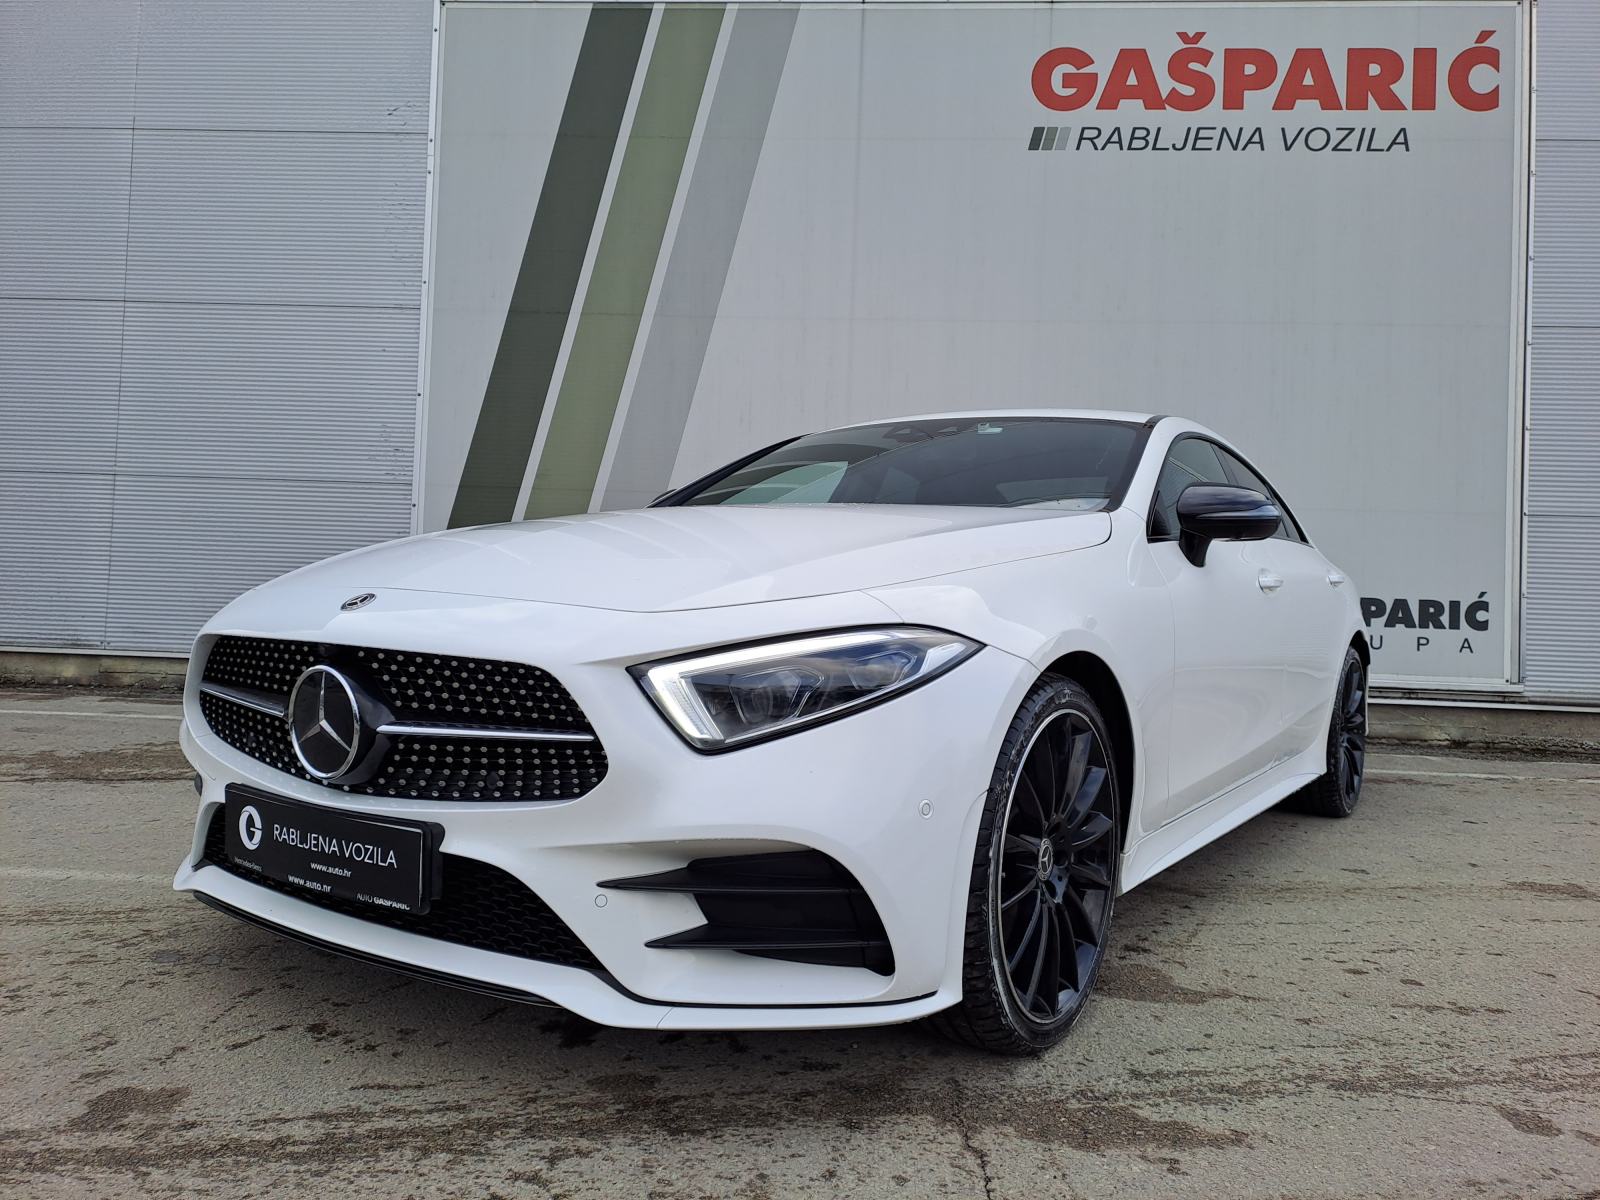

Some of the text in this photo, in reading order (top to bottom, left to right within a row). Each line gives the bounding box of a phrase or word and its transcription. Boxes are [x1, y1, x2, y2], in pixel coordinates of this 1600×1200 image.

[1030, 30, 1500, 112] GAŠPARIĆ
[1076, 126, 1411, 153] RABLJENA VOZILA
[273, 823, 398, 869] RABLJENA VOZILA
[310, 862, 352, 878] www.auto.hr
